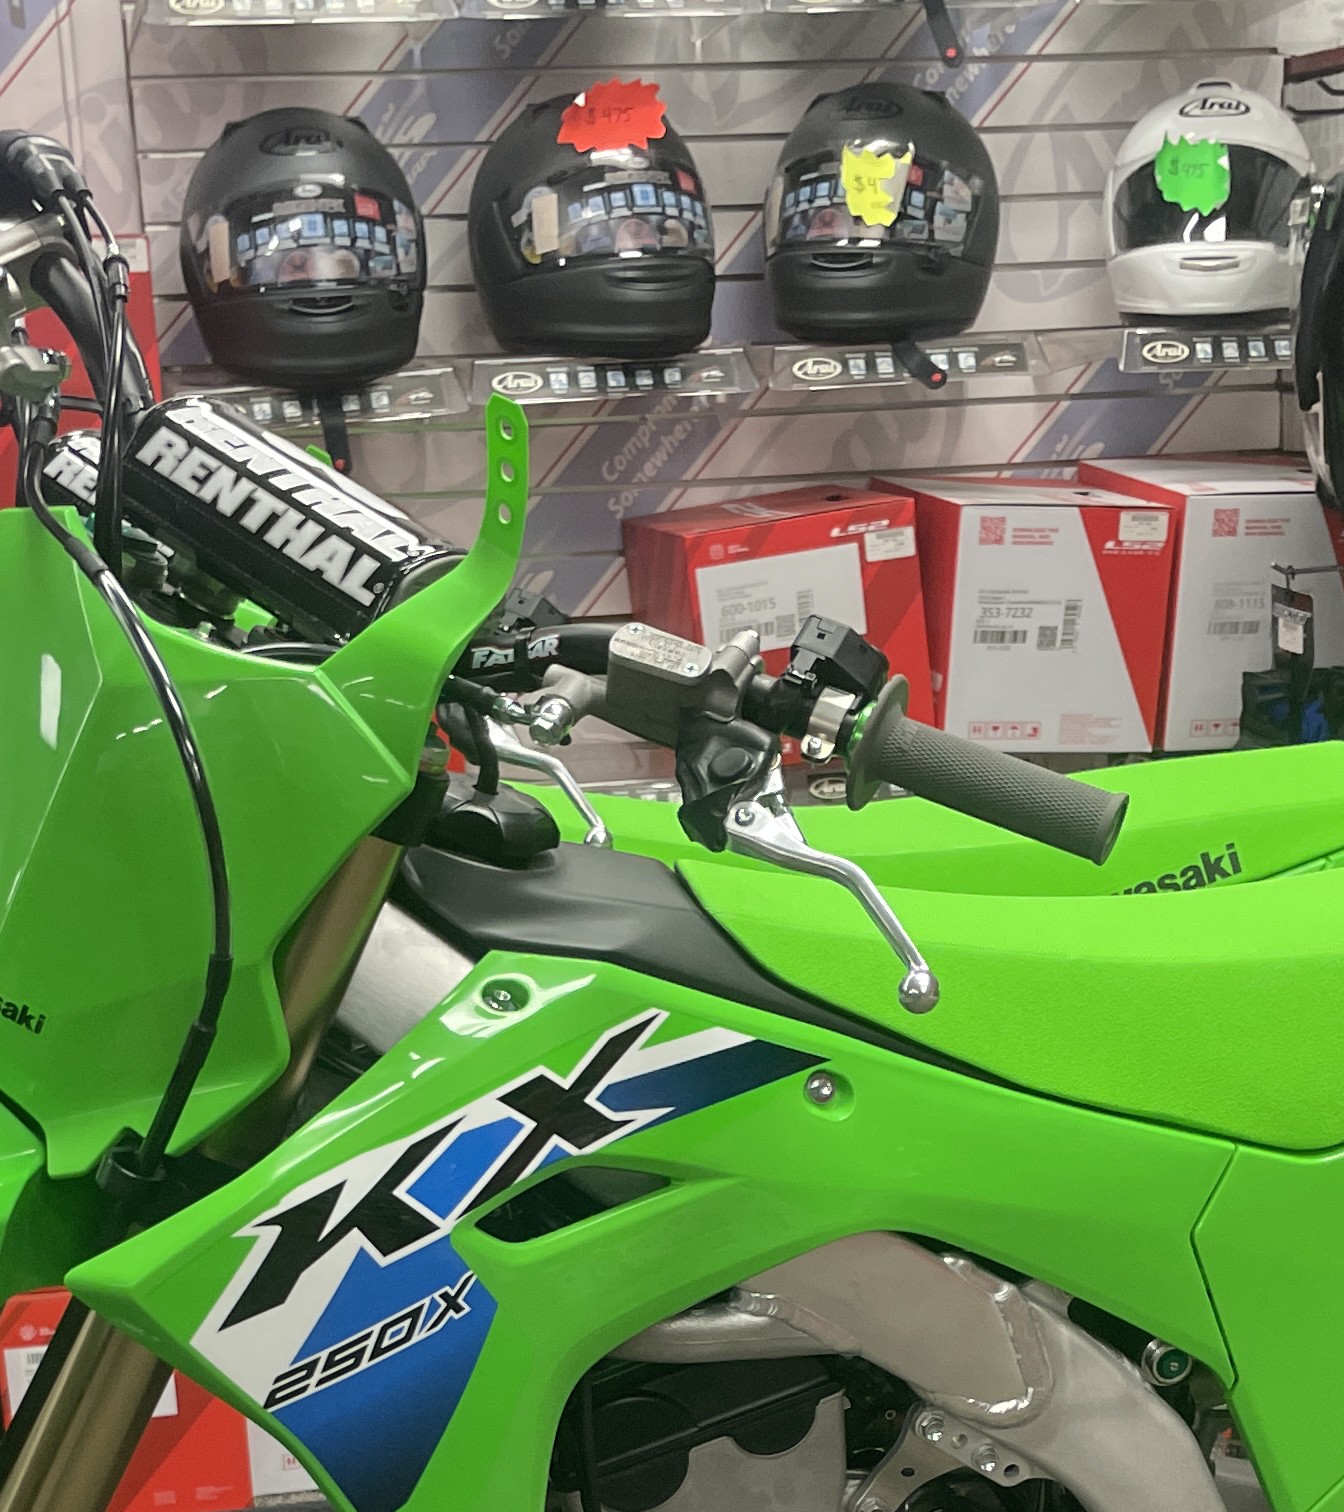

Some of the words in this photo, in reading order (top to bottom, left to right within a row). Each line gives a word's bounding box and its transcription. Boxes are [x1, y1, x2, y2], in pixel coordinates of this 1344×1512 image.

[1179, 97, 1251, 118] Arai
[1142, 340, 1190, 363] Arai
[492, 371, 544, 394] Arai
[792, 357, 843, 381] Arai
[135, 425, 381, 607] RENTHAL
[829, 519, 890, 538] LS2
[472, 635, 559, 669] FATAR
[1118, 842, 1242, 896] asaki
[217, 1012, 661, 1331] KX
[264, 1273, 477, 1410] 250X
